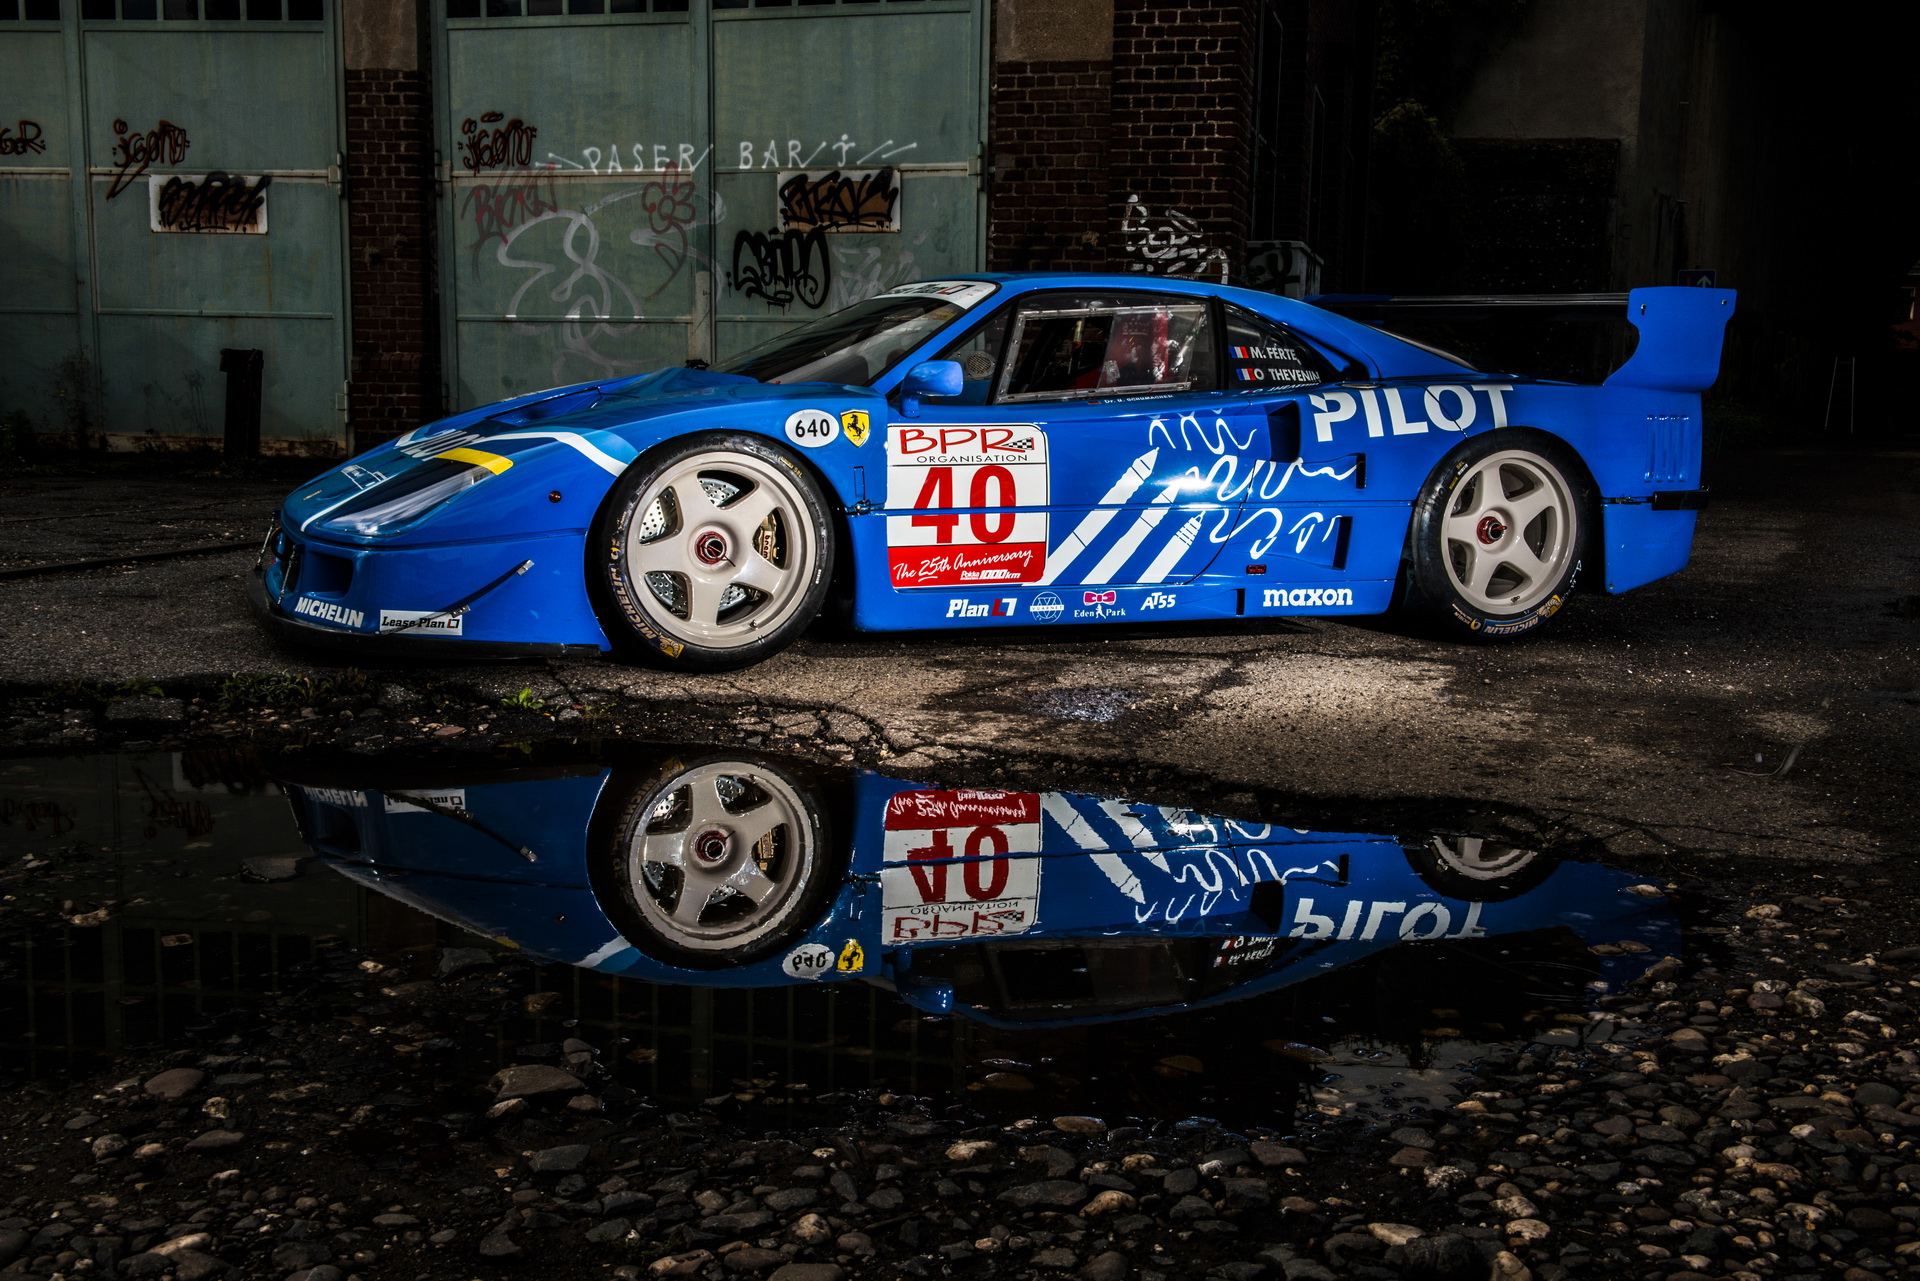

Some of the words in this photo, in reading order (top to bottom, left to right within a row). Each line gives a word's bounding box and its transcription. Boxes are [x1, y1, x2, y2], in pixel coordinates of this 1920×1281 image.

[739, 139, 815, 170] BAR
[1250, 346, 1266, 359] M.
[1268, 368, 1321, 384] THEVENIN
[1308, 384, 1514, 442] PILOT
[795, 418, 830, 437] 640
[900, 428, 1026, 455] BPR
[916, 454, 1028, 464] ORGANISATION
[911, 465, 1016, 544] 40
[893, 562, 917, 579] The
[918, 556, 952, 577] 25th
[953, 549, 1033, 571] Anniversary
[610, 568, 658, 640] MICHELIN
[1263, 588, 1353, 607] maxon
[294, 597, 364, 628] MICHELIN
[946, 600, 990, 617] Plan
[1074, 609, 1095, 618] Eden
[1106, 608, 1127, 617] Park
[382, 616, 416, 628] Lease
[417, 618, 446, 629] Plan
[1484, 616, 1539, 635] MICHELIN
